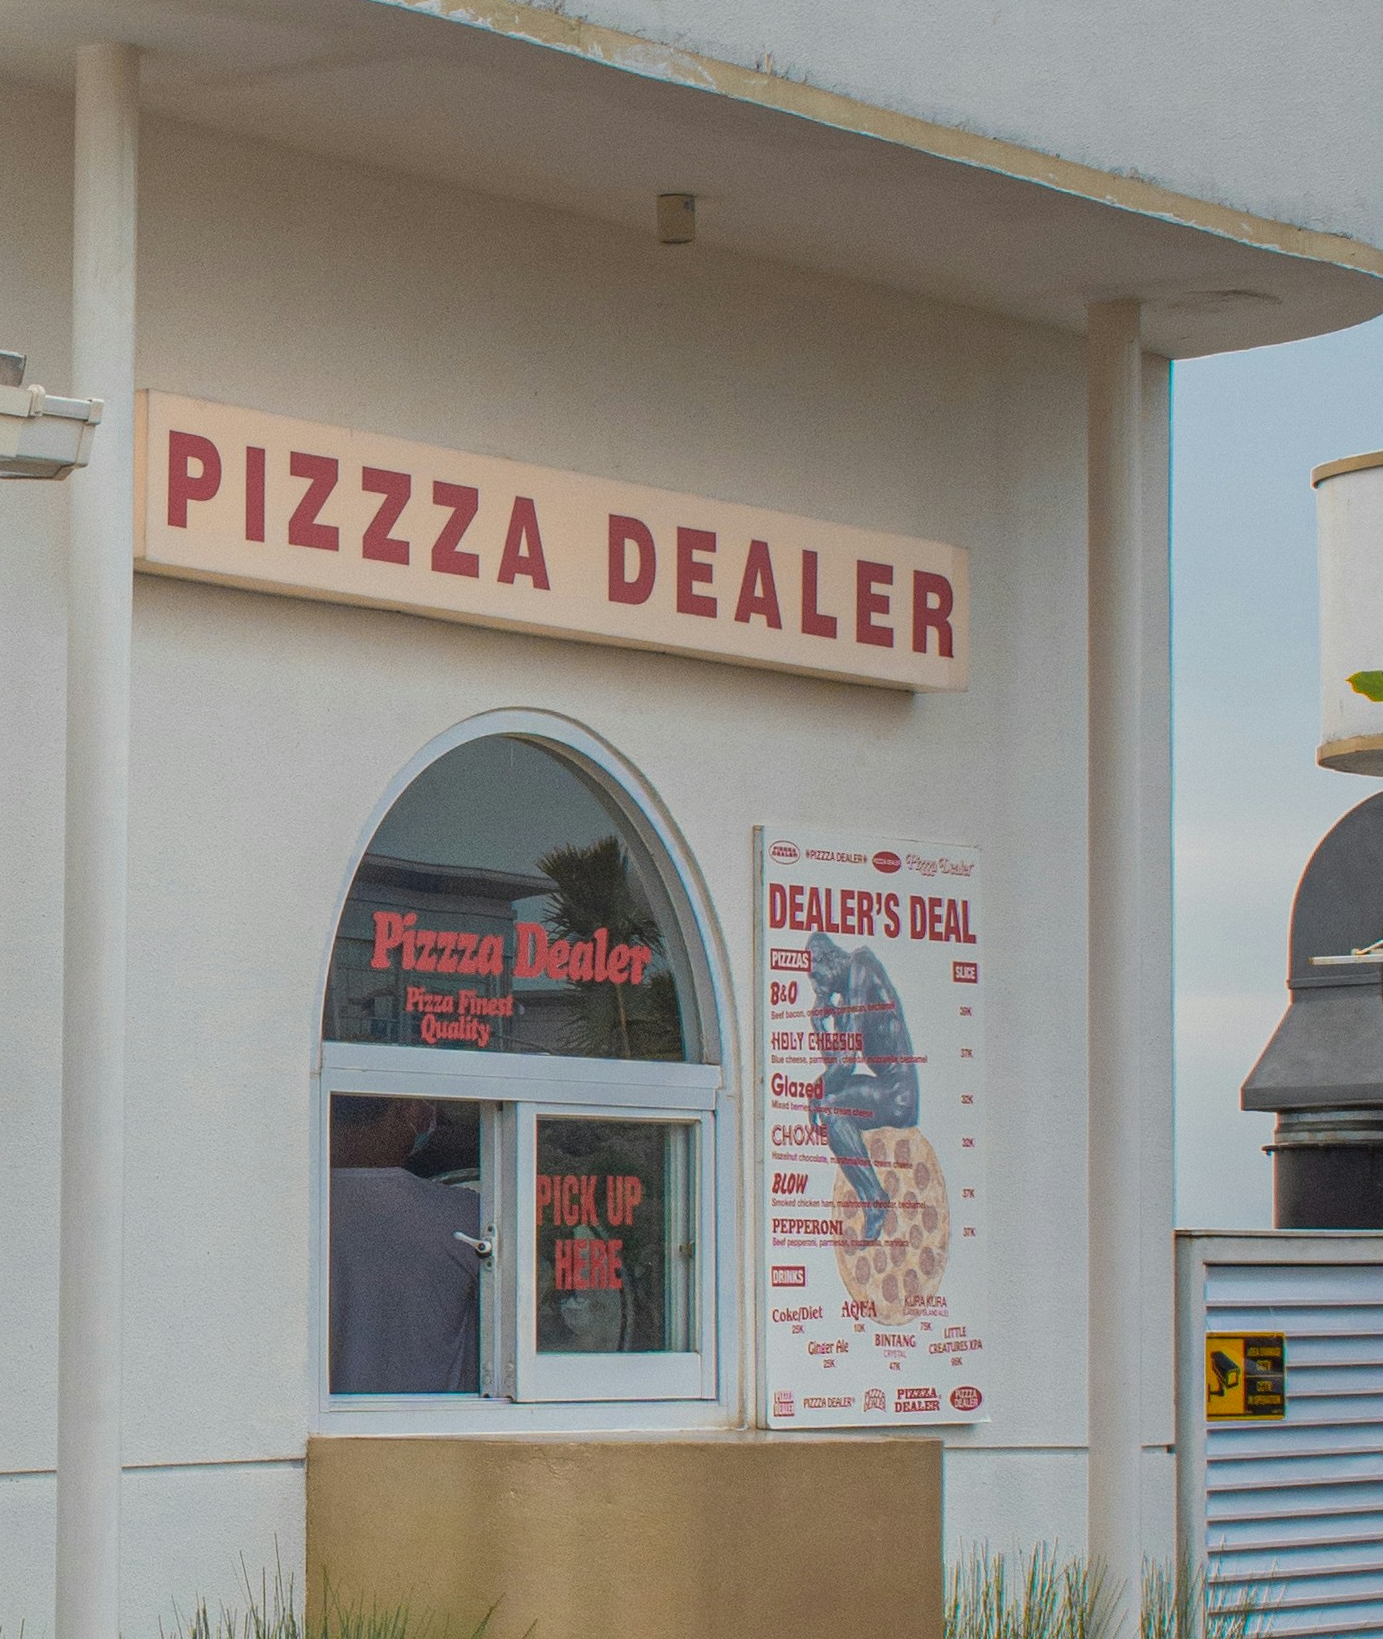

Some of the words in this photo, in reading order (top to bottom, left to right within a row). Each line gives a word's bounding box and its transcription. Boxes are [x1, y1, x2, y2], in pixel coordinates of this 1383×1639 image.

[167, 430, 551, 591] PIZZZA
[607, 513, 955, 659] DEALER
[769, 883, 901, 939] DEALER'S
[909, 894, 978, 944] DEAL
[370, 911, 505, 977] Pizzza
[512, 922, 653, 986] Dealer
[771, 951, 810, 969] PIZZZAS
[405, 986, 455, 1014] Pizza
[458, 989, 514, 1017] Finest
[420, 1014, 491, 1048] Quality
[771, 1031, 805, 1051] HOLY
[771, 1072, 824, 1100] Glazed
[771, 1172, 809, 1195] BLOW
[536, 1175, 598, 1226] PICK
[606, 1175, 644, 1226] UP
[772, 1218, 844, 1236] PEPPERONI
[554, 1239, 624, 1290] HERE
[772, 1269, 804, 1283] DRINKS
[772, 1305, 823, 1322] Coke/Diet
[874, 1333, 916, 1348] BINTANG
[944, 1326, 967, 1339] LITTLE
[894, 1400, 940, 1413] DEALER
